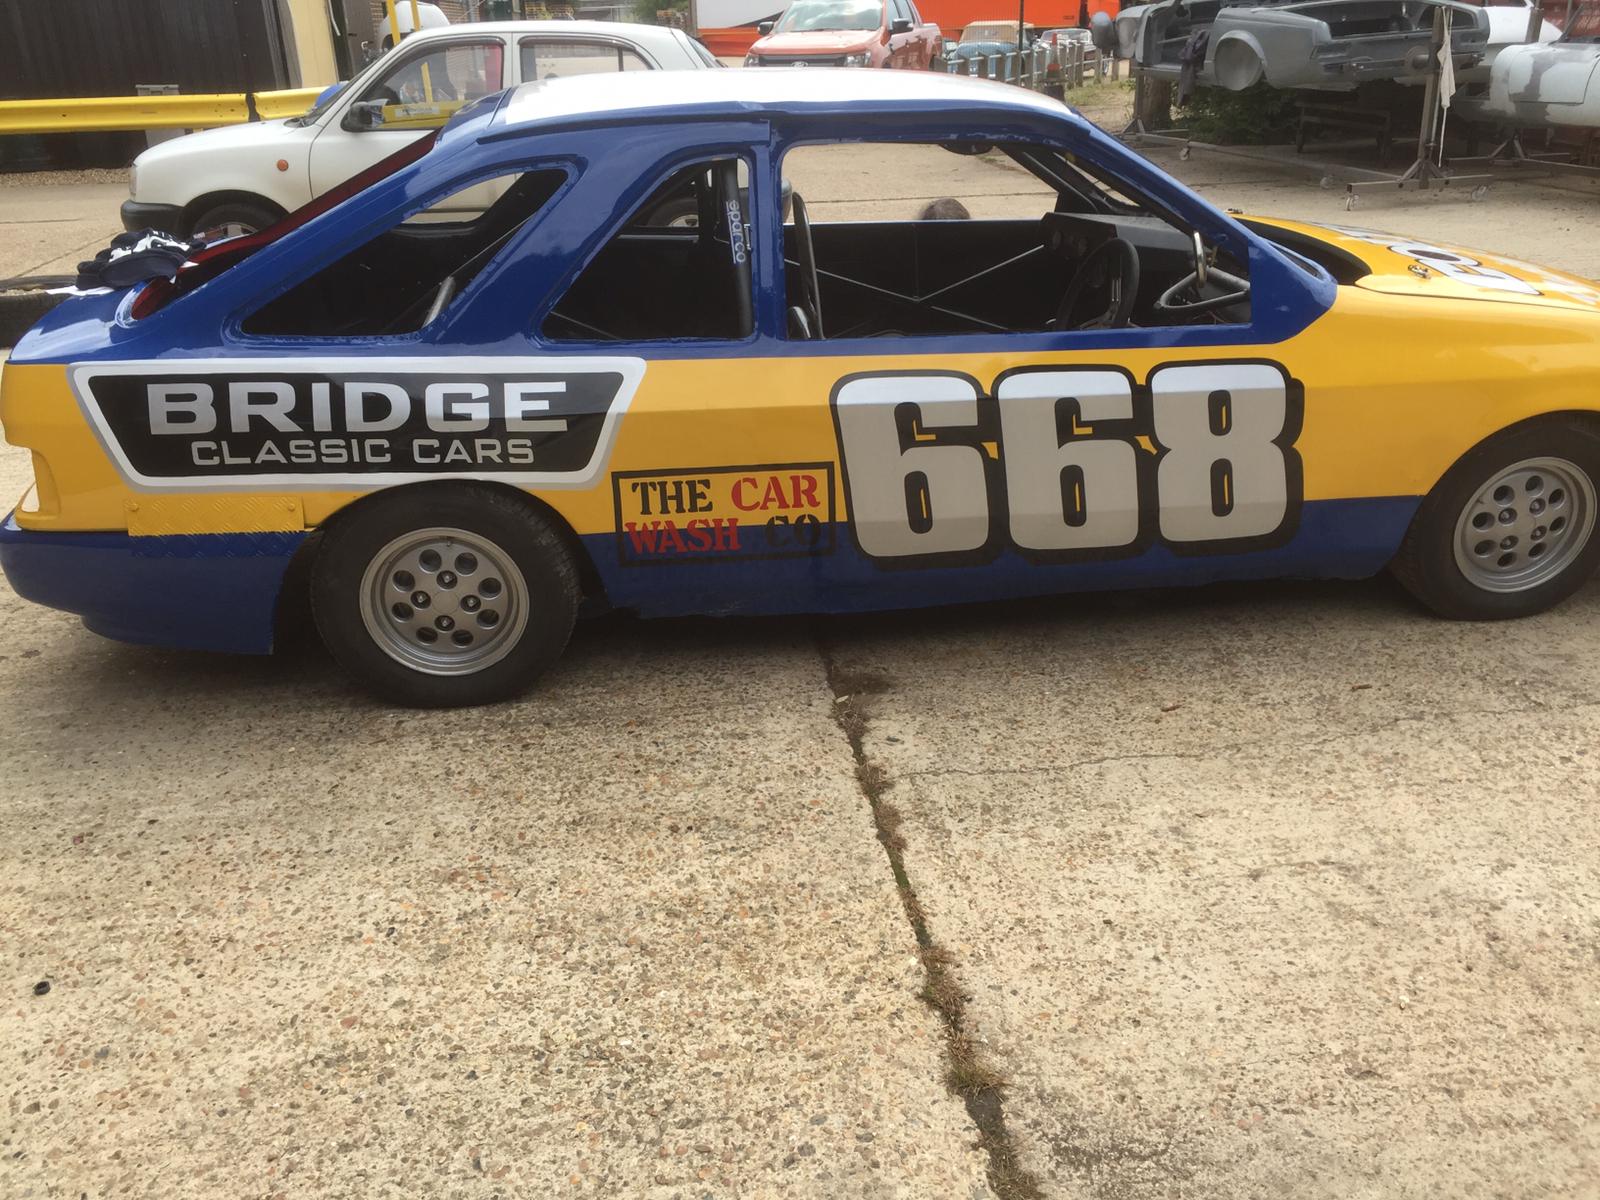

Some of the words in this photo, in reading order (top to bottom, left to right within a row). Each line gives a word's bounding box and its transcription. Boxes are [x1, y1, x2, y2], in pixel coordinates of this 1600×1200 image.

[147, 382, 568, 435] BRIDGE
[191, 439, 391, 465] CLASSIC
[413, 438, 535, 464] CARS
[830, 358, 1304, 570] 668
[632, 479, 713, 515] THE
[731, 475, 821, 511] CAR
[625, 518, 742, 555] WASH
[765, 514, 822, 548] CO
